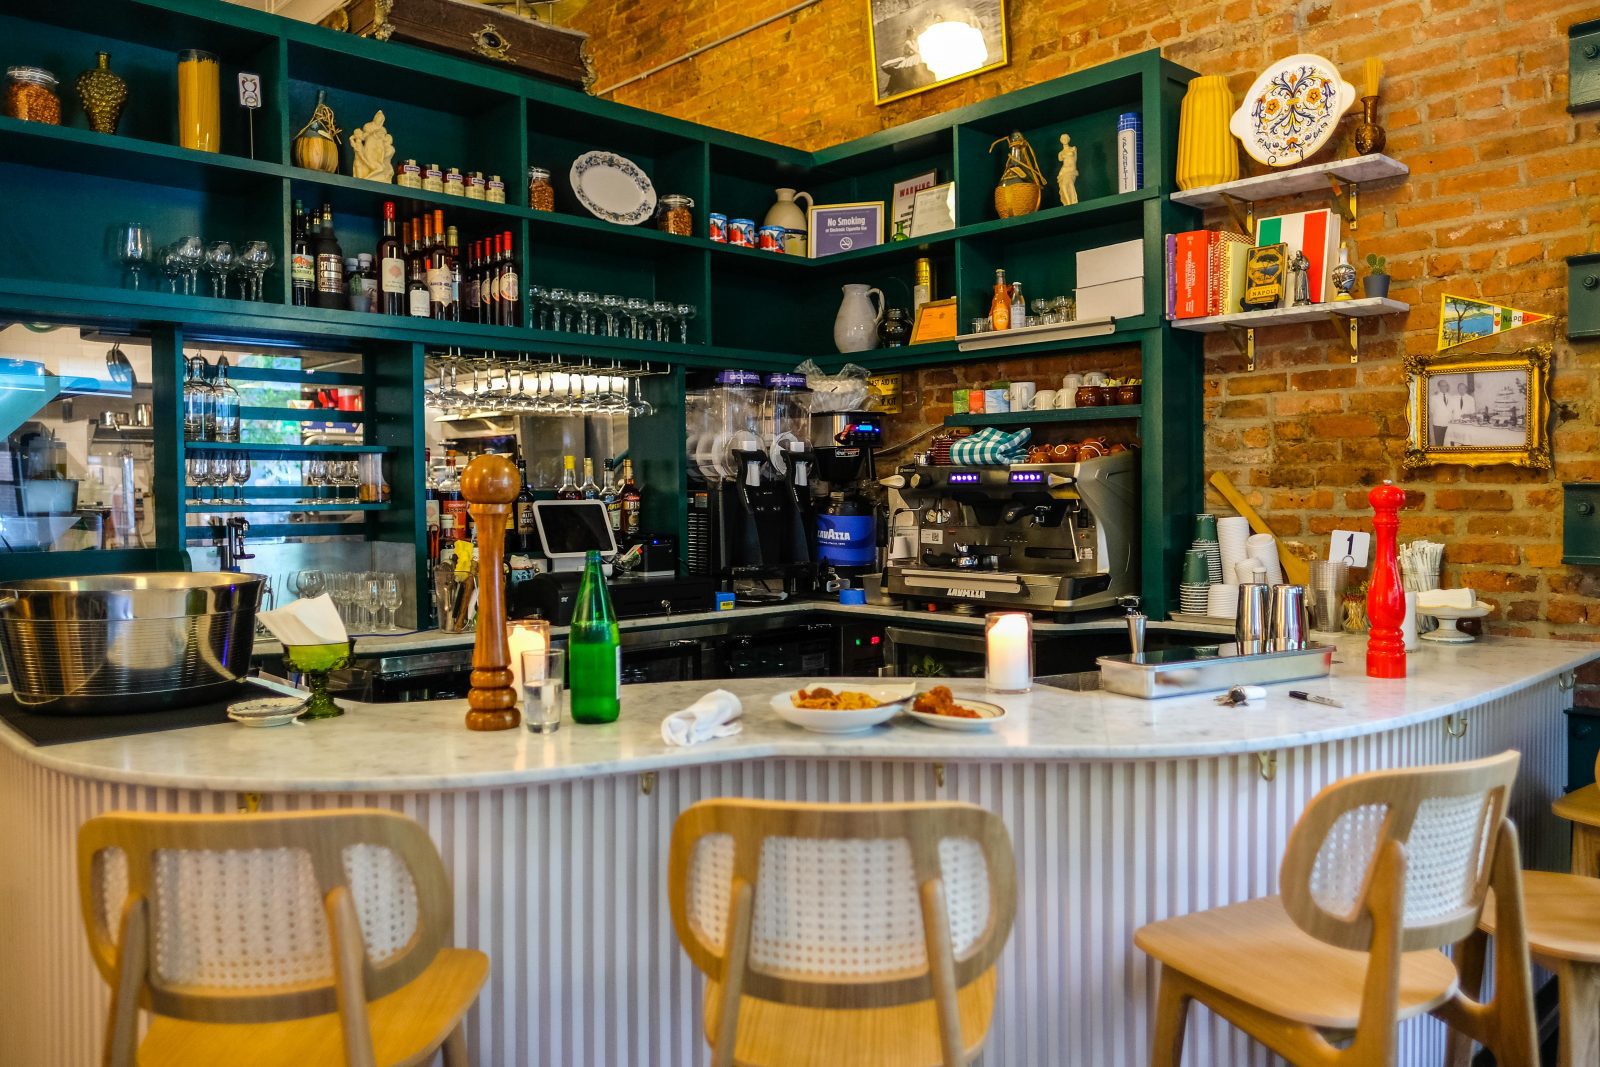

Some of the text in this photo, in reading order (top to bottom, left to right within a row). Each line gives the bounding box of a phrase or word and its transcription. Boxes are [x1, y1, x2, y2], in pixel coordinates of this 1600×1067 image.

[827, 216, 866, 227] No Smoking
[1252, 288, 1277, 297] NAPOLI
[1502, 315, 1529, 323] NAPOLI
[817, 528, 851, 541] LAVAZZA
[1347, 533, 1354, 556] 1
[947, 588, 986, 599] LAVAZZA
